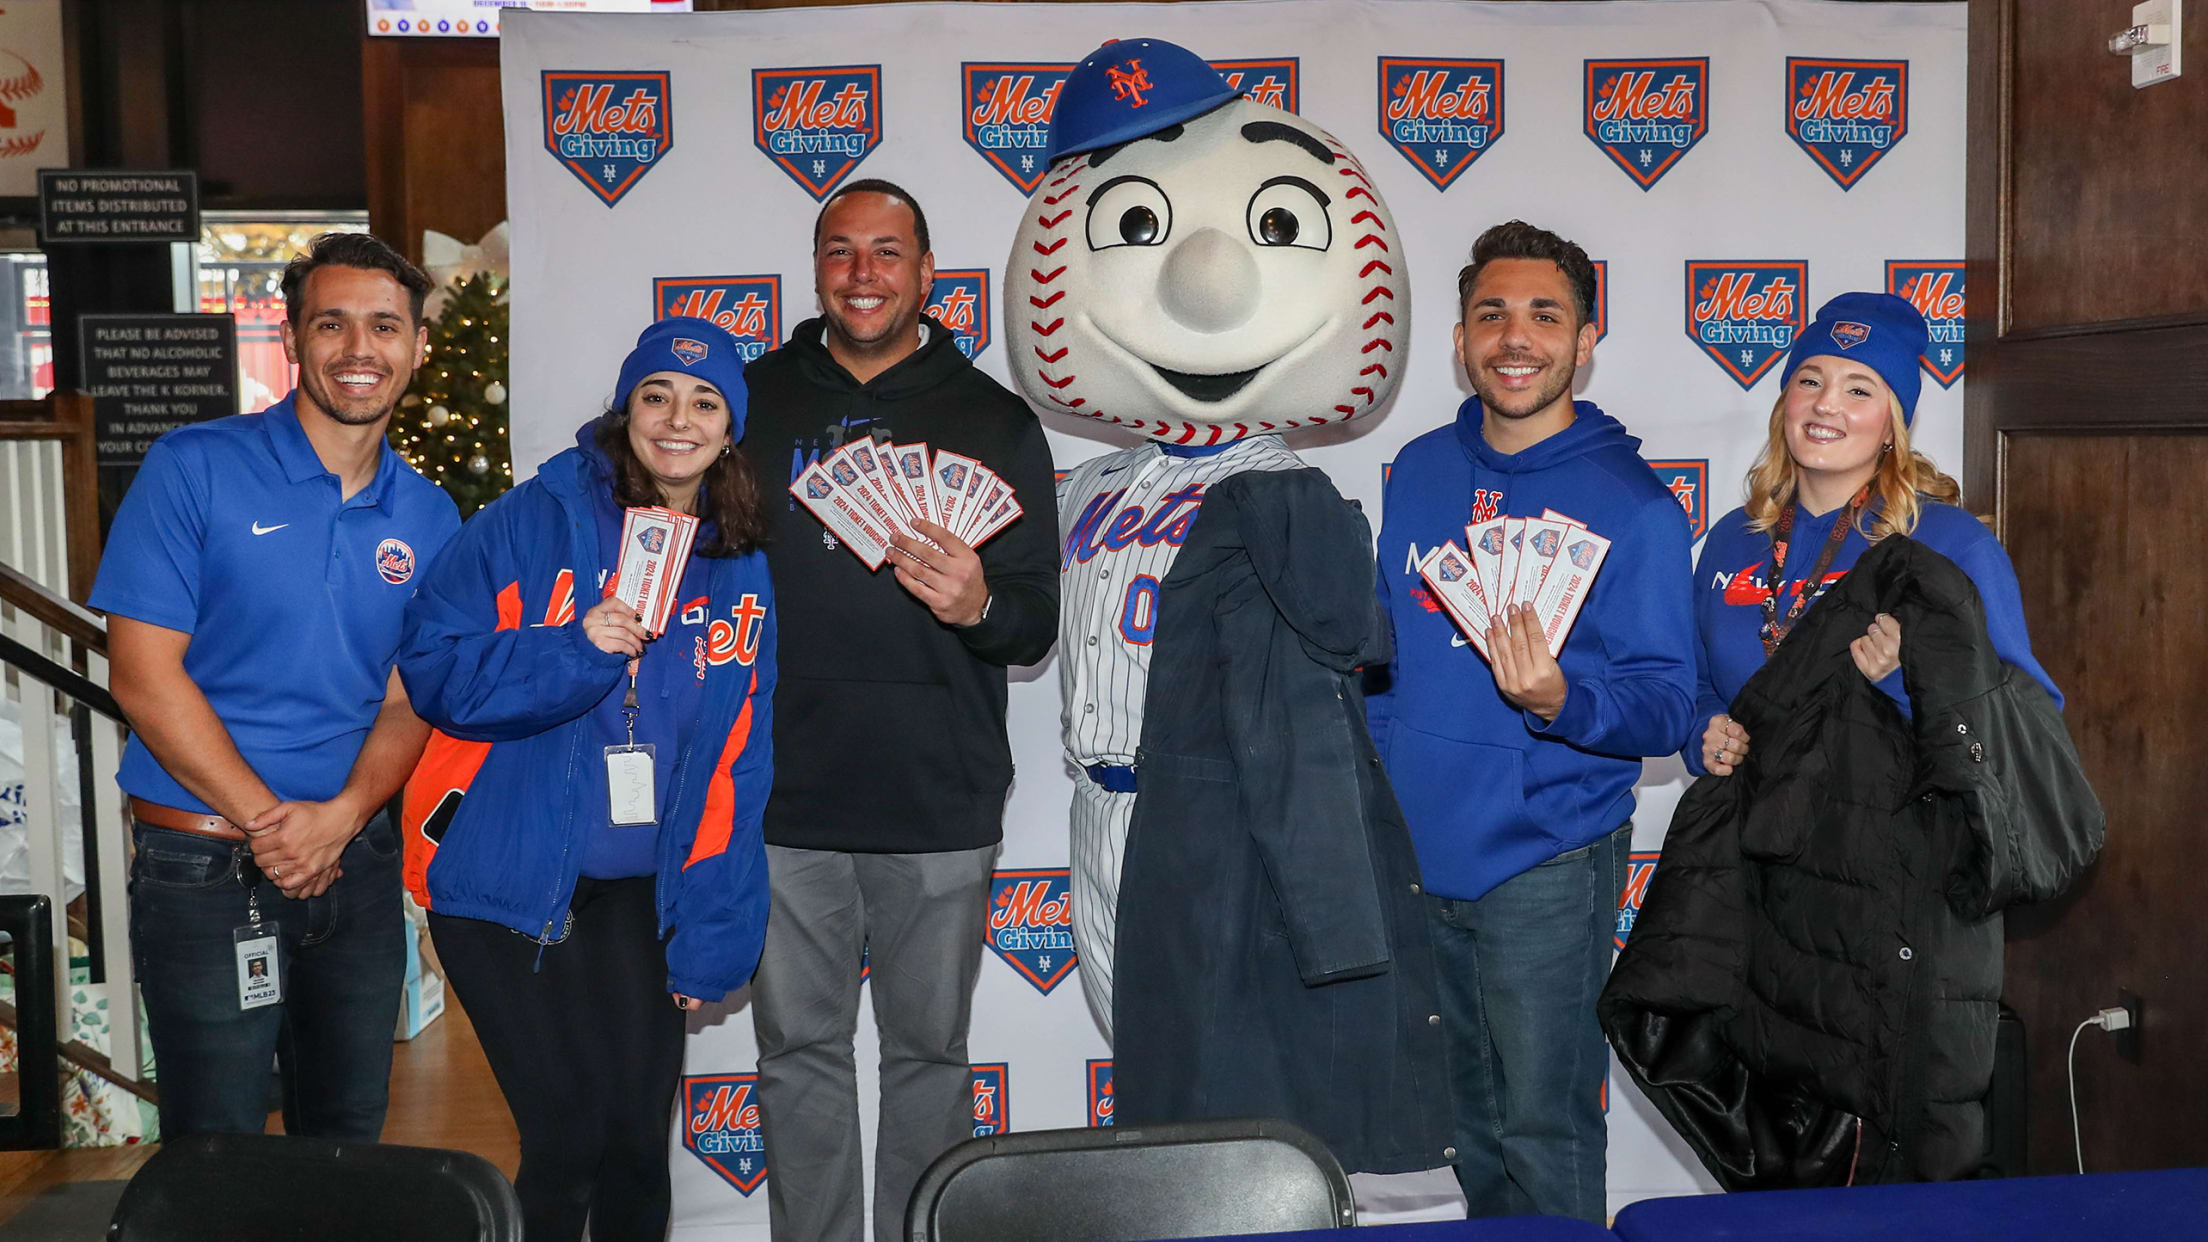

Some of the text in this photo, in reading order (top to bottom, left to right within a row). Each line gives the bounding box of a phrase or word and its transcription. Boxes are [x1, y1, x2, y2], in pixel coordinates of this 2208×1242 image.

[1104, 58, 1154, 109] NY
[1388, 70, 1491, 121] Mets
[1593, 71, 1697, 121] Mets
[1794, 71, 1896, 121] Mets
[554, 84, 658, 135] Mets
[763, 80, 868, 131] Mets
[972, 75, 1066, 125] Met
[769, 128, 866, 157] Giving
[978, 123, 1048, 148] Givi
[1393, 118, 1488, 148] Giving
[1598, 116, 1693, 148] Giving
[1799, 118, 1893, 149] Giving
[560, 128, 657, 163] Giving
[56, 179, 180, 192] NO PROMOTIONAL
[52, 200, 187, 213] ITEMS DISTRIBUTED
[57, 220, 184, 233] AT THIS ENTRANCE
[1695, 272, 1797, 322] Mets
[96, 328, 219, 340] PLEASE BE ADVISED
[1700, 318, 1793, 348] Giving
[94, 347, 223, 359] THAT NO ALCOHOLIC
[107, 366, 211, 378] BEVERAGES MAY
[91, 385, 229, 397] LEAVE THE K KORNER.
[124, 404, 198, 416] THANK YOU
[109, 422, 181, 434] IN ADVAN
[97, 442, 133, 453] YOUR
[915, 484, 925, 500] 2024
[944, 495, 957, 512] 2024
[833, 495, 849, 512] 2024
[846, 505, 866, 528] TICKET
[863, 520, 889, 550] VOUCHER
[857, 485, 901, 535] 2024 TICKET VOUC
[1062, 482, 1205, 573] Mets
[381, 553, 408, 573] Mets
[645, 560, 657, 577] 2024
[639, 575, 653, 599] TICKET
[1466, 578, 1482, 596] 2024
[1568, 574, 1582, 593] 2024
[1558, 593, 1574, 616] TICKET
[990, 881, 1071, 930] Met
[997, 926, 1075, 952] Givin
[243, 950, 270, 959] OFFICIAL
[691, 1085, 760, 1134] Me
[697, 1129, 765, 1154] Givi
